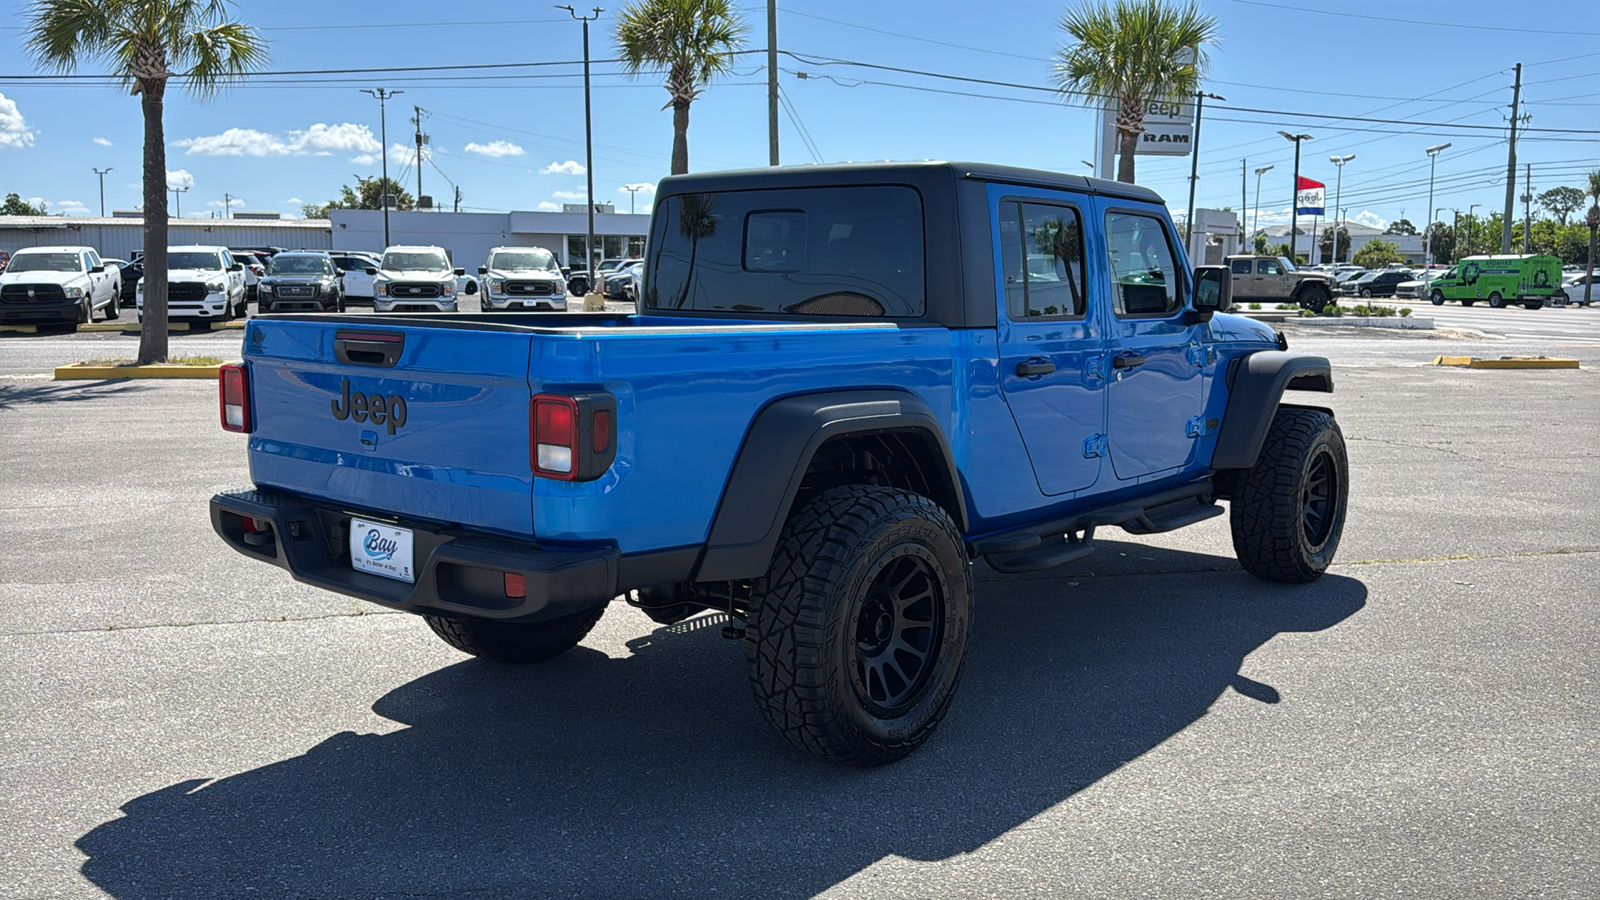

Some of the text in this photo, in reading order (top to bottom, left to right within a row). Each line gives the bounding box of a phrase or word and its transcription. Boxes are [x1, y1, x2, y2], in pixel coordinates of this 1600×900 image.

[1143, 134, 1189, 143] RAM
[330, 380, 407, 436] Jeep
[366, 528, 398, 560] Bay
